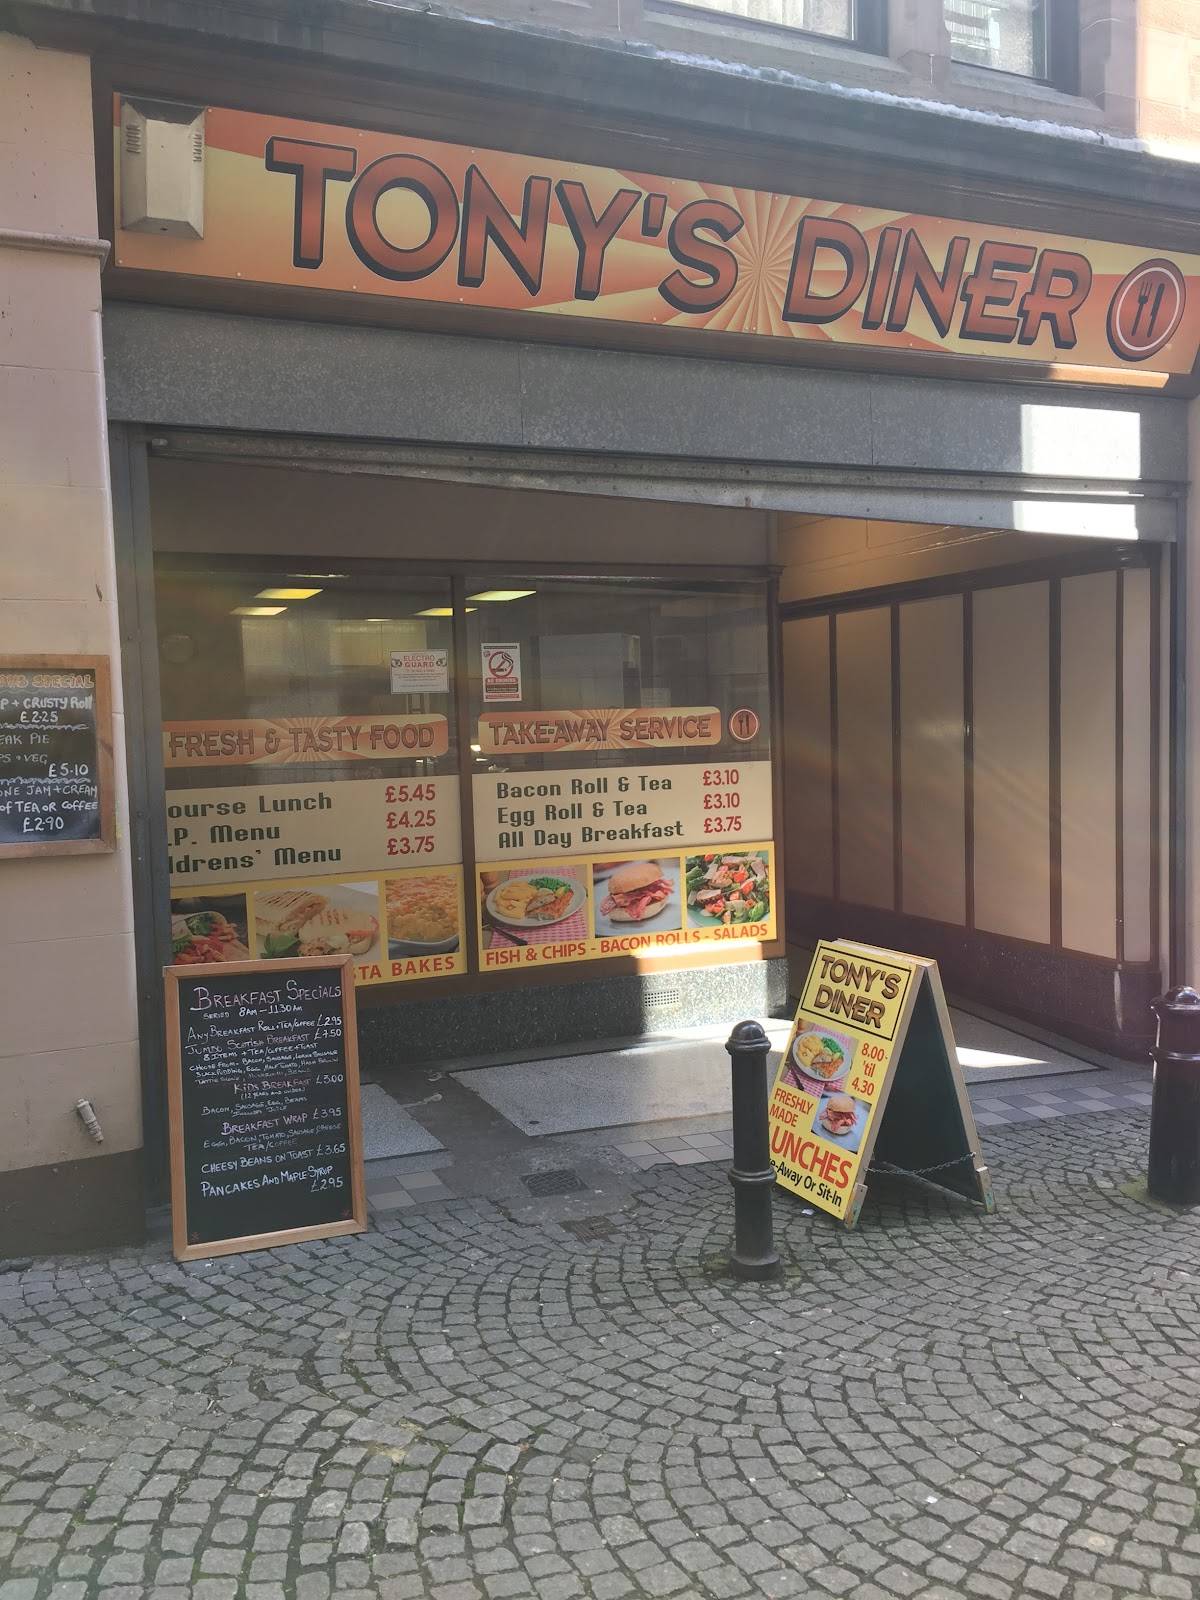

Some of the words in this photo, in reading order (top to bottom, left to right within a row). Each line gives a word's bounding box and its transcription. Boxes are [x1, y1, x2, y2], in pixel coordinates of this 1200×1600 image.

[265, 135, 744, 314] TONY'S
[782, 214, 1093, 351] DINER
[30, 732, 50, 744] PIE
[169, 727, 255, 758] FRESH
[265, 728, 280, 754] &
[288, 725, 362, 753] TASTY
[369, 723, 435, 751] FOOD
[488, 717, 611, 746] TAKE-AWAY
[619, 715, 712, 742] SERVICE
[24, 754, 48, 765] VEG
[496, 782, 561, 799] Bacon
[571, 777, 608, 795] Roll
[618, 776, 630, 792] &
[638, 775, 672, 792] Tea
[702, 768, 740, 786] £3.10
[27, 785, 51, 796] JAM
[62, 784, 98, 798] CREAM
[385, 783, 436, 803] £5.45
[703, 792, 740, 810] £3.10
[15, 801, 41, 813] TEA
[259, 792, 332, 813] Lunch
[385, 809, 436, 829] £4.25
[497, 806, 535, 828] Egg
[545, 803, 582, 822] Roll
[592, 801, 604, 818] &
[612, 800, 647, 817] Tea
[703, 815, 742, 834] £3.75
[210, 825, 280, 844] Menu
[498, 831, 524, 848] All
[534, 828, 572, 848] Day
[581, 820, 686, 843] Breakfast
[274, 846, 342, 867] Menu
[386, 835, 435, 856] £3.75
[485, 948, 522, 966] FISH
[525, 947, 540, 963] &
[542, 942, 586, 960] CHIPS
[600, 935, 650, 954] BACON
[655, 930, 700, 946] ROLLS
[713, 923, 768, 941] SALADS
[354, 965, 382, 980] TA
[391, 956, 455, 977] BAKES
[820, 955, 902, 1000] TONY'S
[190, 986, 282, 1011] BREAKFAST
[813, 984, 886, 1029] DINER
[209, 1024, 256, 1037] BREAKFAST
[185, 1043, 223, 1055] JUMBO
[266, 1033, 310, 1045] BREAKFAST
[861, 1043, 885, 1062] 8.00
[863, 1060, 876, 1078] 'til
[262, 1078, 311, 1090] BREAKFAST
[851, 1077, 875, 1096] 4.30
[774, 1088, 814, 1116] FRESHLY
[221, 1119, 280, 1136] BREAKFAST
[283, 1113, 308, 1126] WRAP
[769, 1104, 799, 1127] MADE
[201, 1160, 238, 1174] CHEESY
[240, 1156, 273, 1168] BEANS
[275, 1153, 287, 1162] ON
[287, 1149, 314, 1159] TOAST
[769, 1121, 852, 1189] UNCHES
[200, 1179, 260, 1197] PANCAKES
[280, 1170, 307, 1183] MAPLE
[307, 1165, 333, 1180] SYRUP
[769, 1158, 803, 1187] e-Away
[803, 1175, 816, 1191] Or
[816, 1182, 842, 1208] Sit-In
